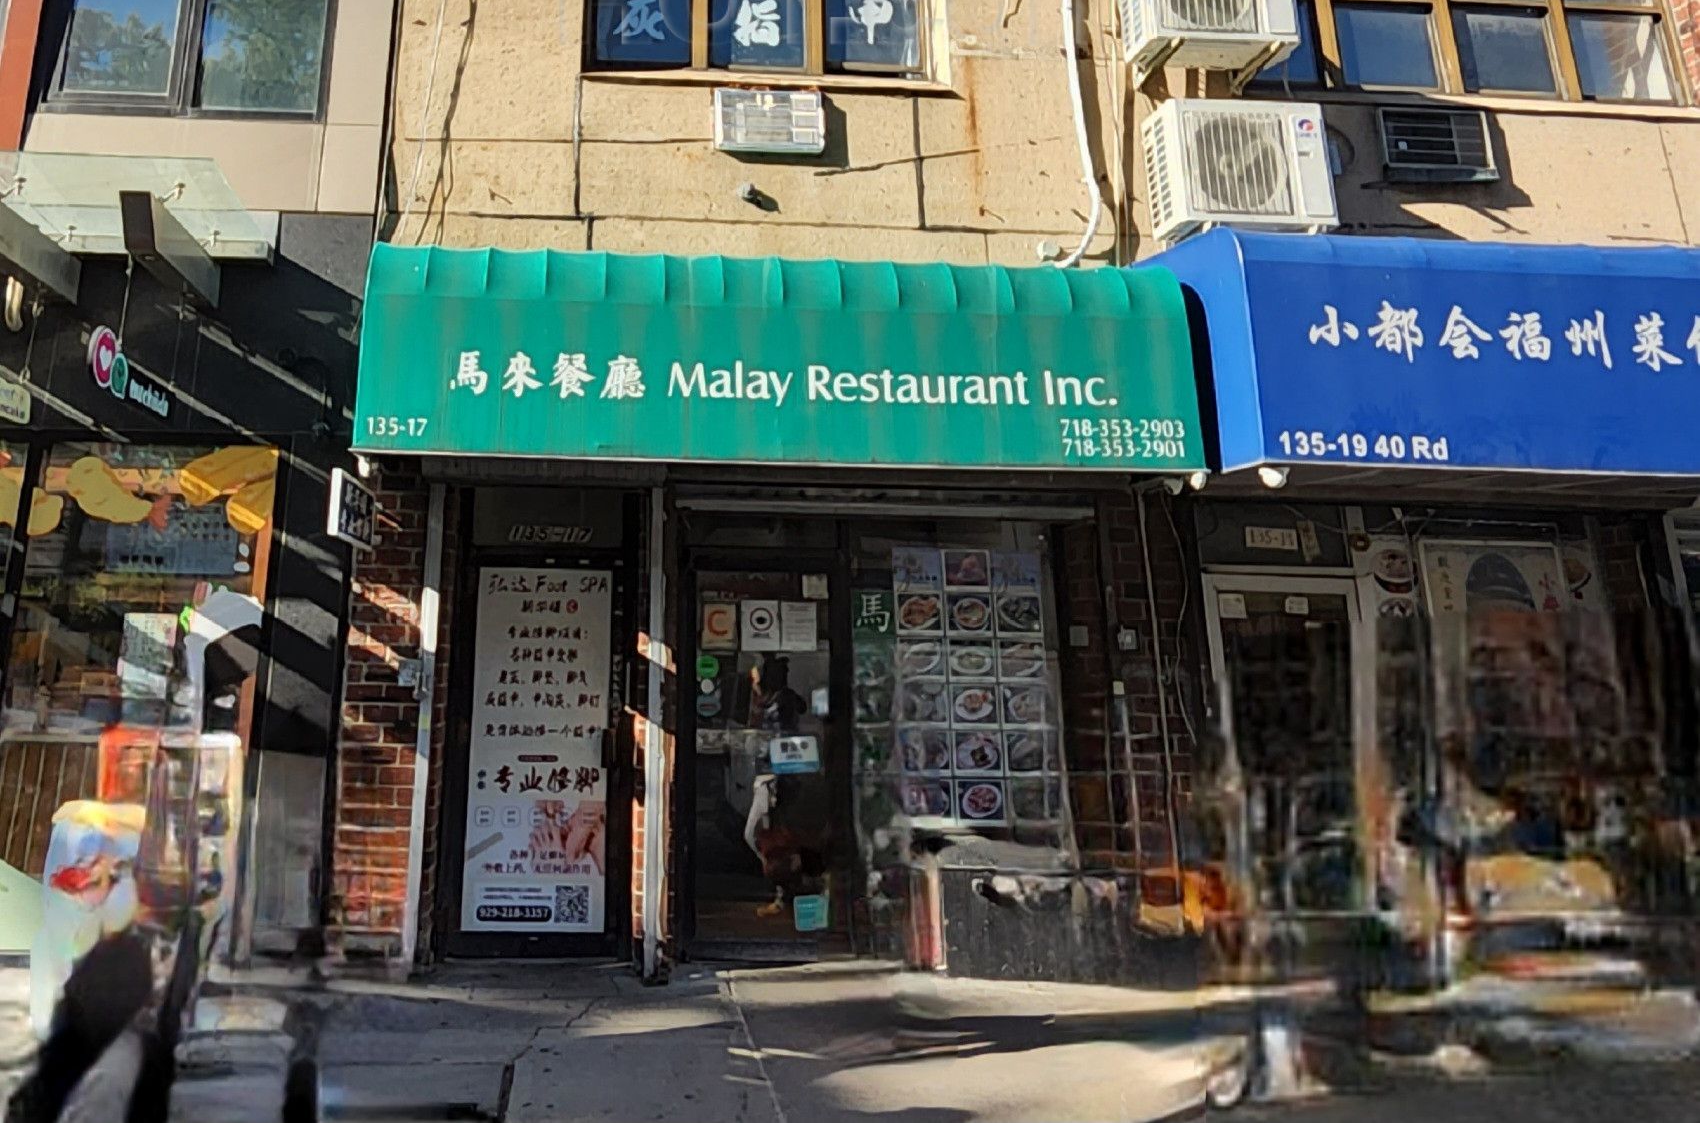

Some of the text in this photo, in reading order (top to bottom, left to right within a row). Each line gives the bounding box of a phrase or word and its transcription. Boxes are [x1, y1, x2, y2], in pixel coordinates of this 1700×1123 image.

[1309, 300, 1700, 372] 小都会福州菜
[450, 351, 1118, 407] 馬來餐廳 Malay Restaurant Inc.
[367, 416, 428, 437] 135-17
[1060, 418, 1185, 438] 718-353-2903
[1062, 437, 1185, 458] 718-353-2901
[1279, 430, 1449, 461] 135-19 40 Rd
[579, 576, 609, 593] SPA
